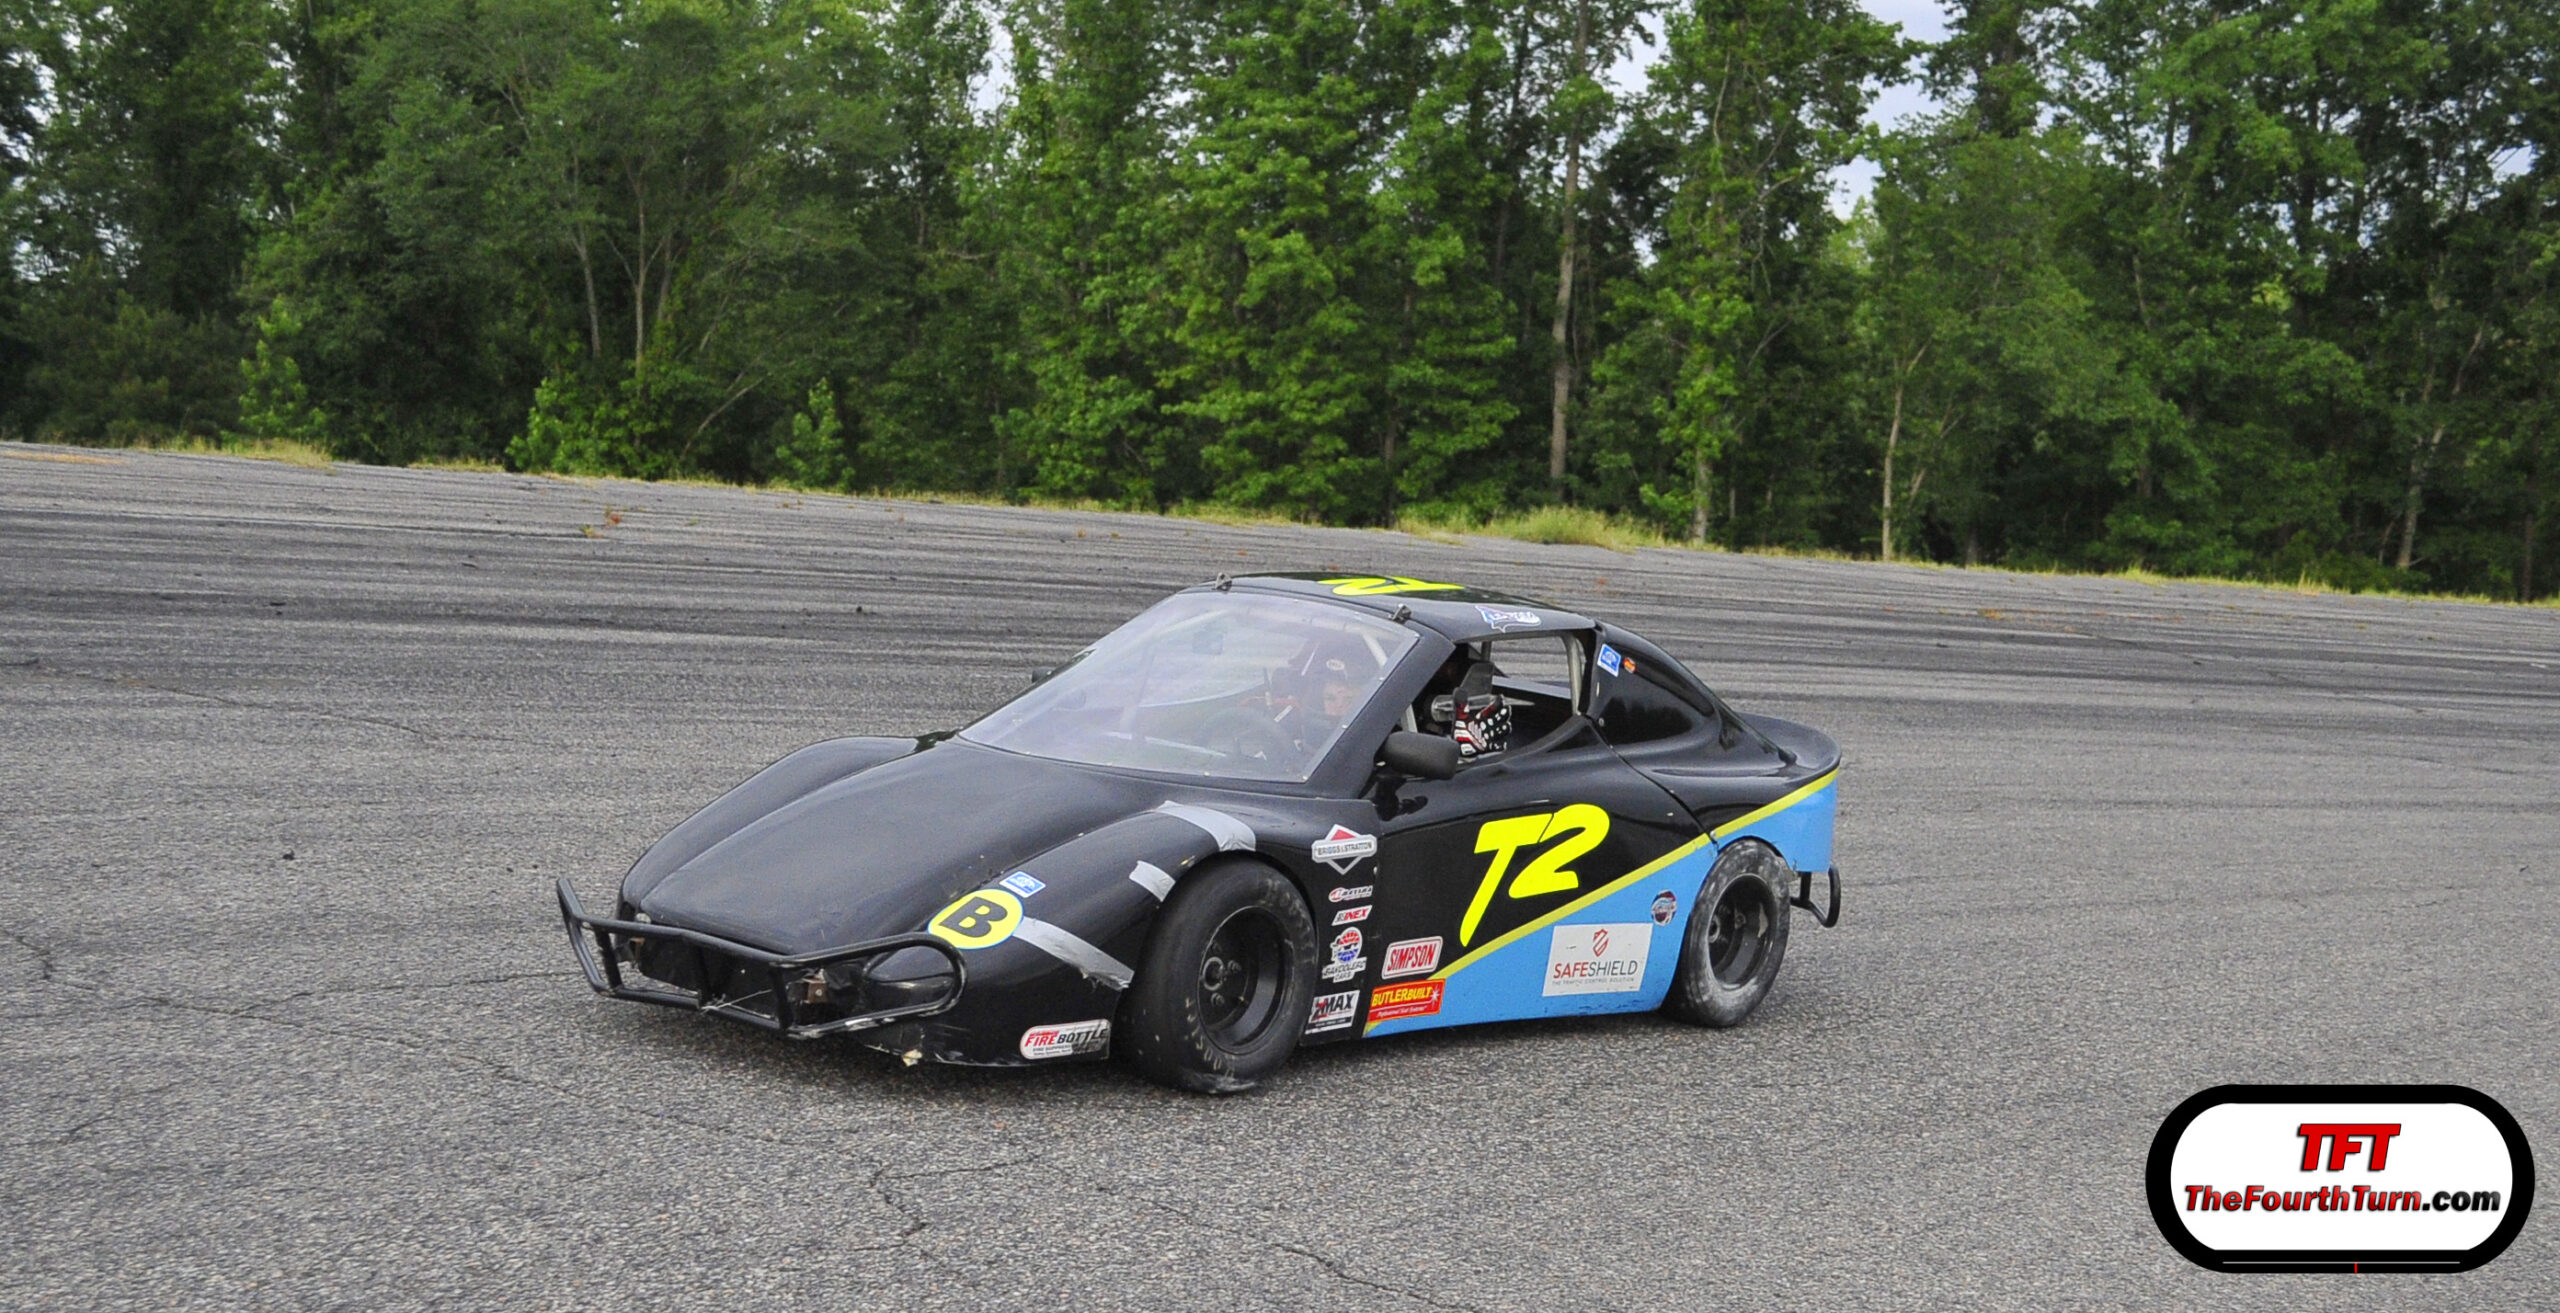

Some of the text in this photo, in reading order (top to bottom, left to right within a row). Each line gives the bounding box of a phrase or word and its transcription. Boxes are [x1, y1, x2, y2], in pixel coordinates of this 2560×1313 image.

[1459, 803, 1610, 947] T2
[938, 896, 1008, 937] B
[1387, 943, 1436, 971] SIMPSON
[1553, 960, 1638, 978] SAFESHIELD
[1372, 987, 1433, 1006] BUTLERBUILT
